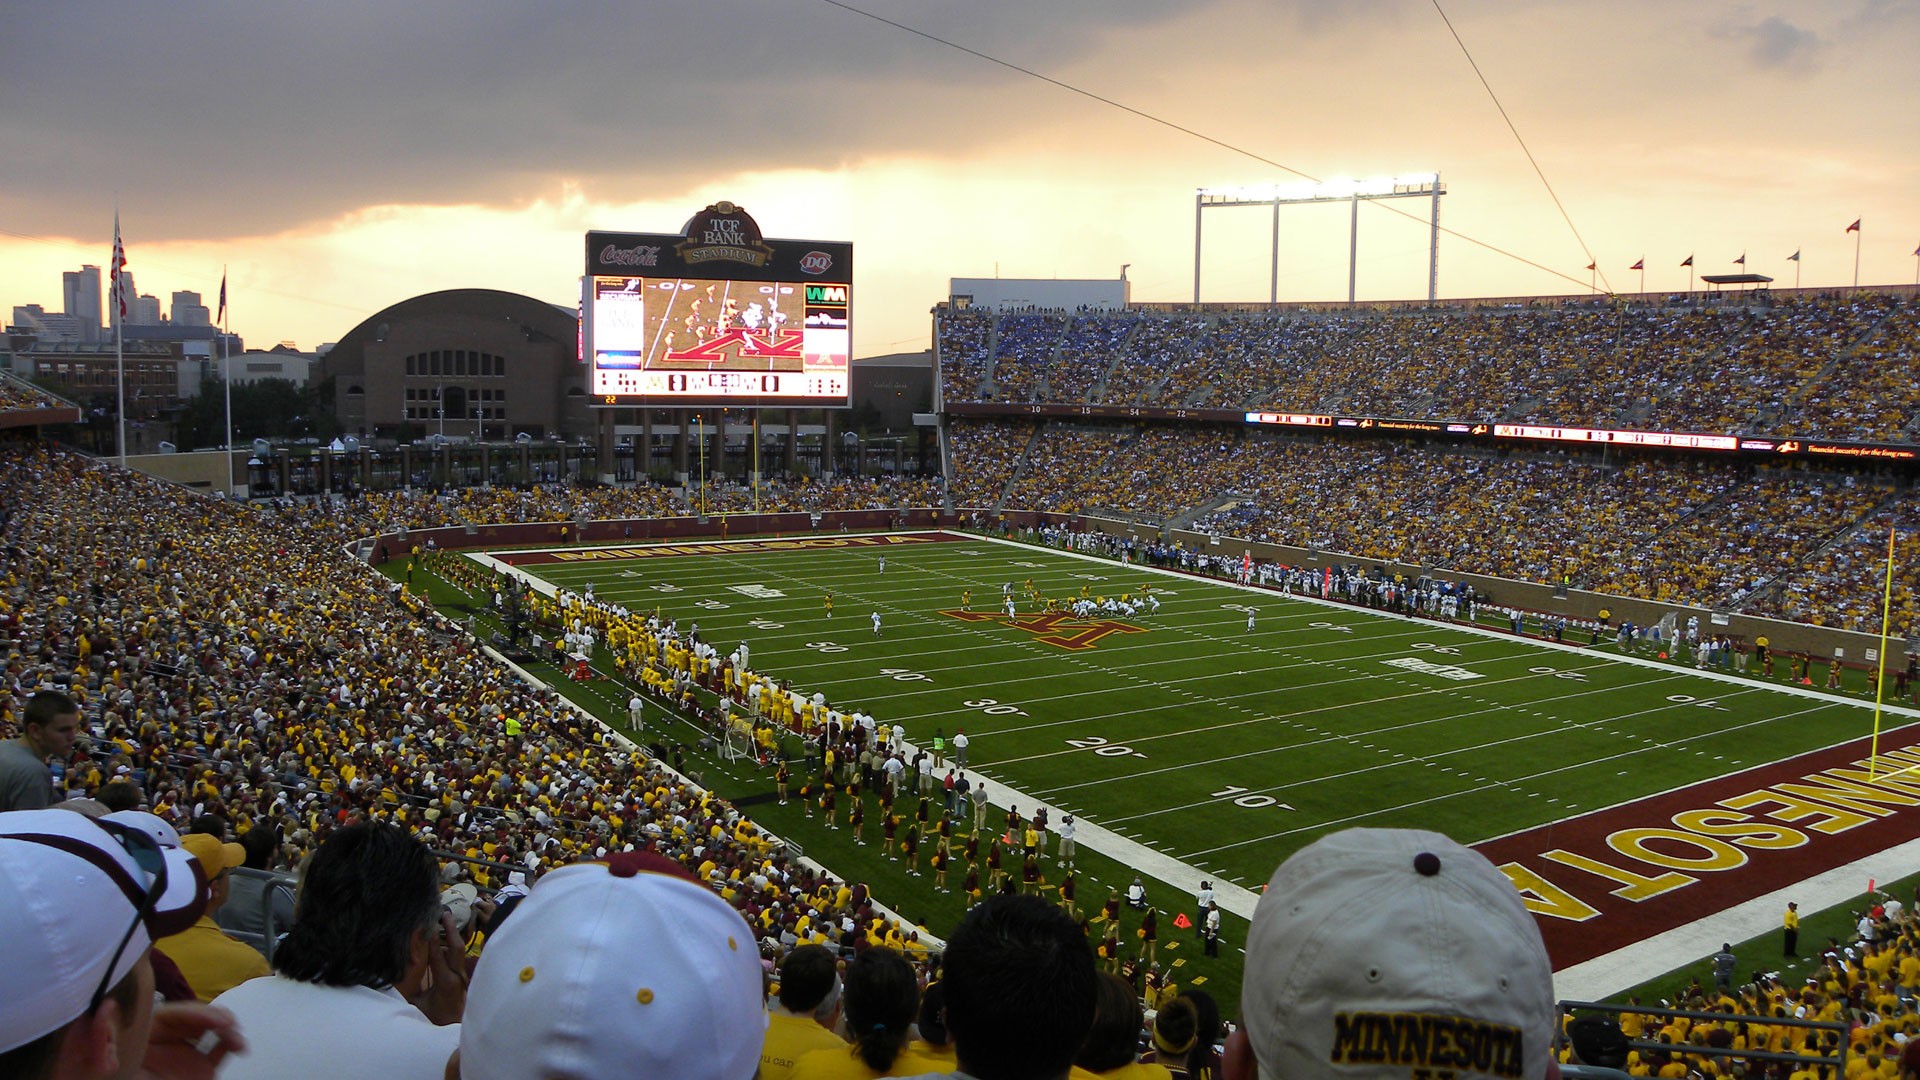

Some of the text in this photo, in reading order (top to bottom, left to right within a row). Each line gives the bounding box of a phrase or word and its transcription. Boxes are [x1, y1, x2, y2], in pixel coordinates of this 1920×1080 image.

[710, 219, 740, 233] TCF
[704, 231, 745, 245] BANK
[600, 244, 661, 266] Coca-Cola
[692, 249, 756, 262] STADIUM
[806, 256, 827, 270] DQ
[807, 287, 846, 302] WM
[1031, 405, 1041, 413] 10
[1081, 406, 1091, 414] 15
[1129, 408, 1139, 416] 54
[1808, 445, 1836, 453] Financial
[1836, 447, 1860, 456] security
[1860, 448, 1871, 456] for
[1871, 448, 1882, 456] the
[1882, 449, 1896, 458] long
[551, 534, 935, 561] MINNESOTA
[805, 641, 849, 653] 50
[879, 668, 926, 681] 40
[963, 698, 1019, 716] 30
[1064, 736, 1134, 758] 20
[1210, 785, 1277, 809] 10
[1498, 743, 1920, 922] NNESOTA
[1330, 1011, 1524, 1077] MINNESOTA
[773, 1057, 794, 1068] can
